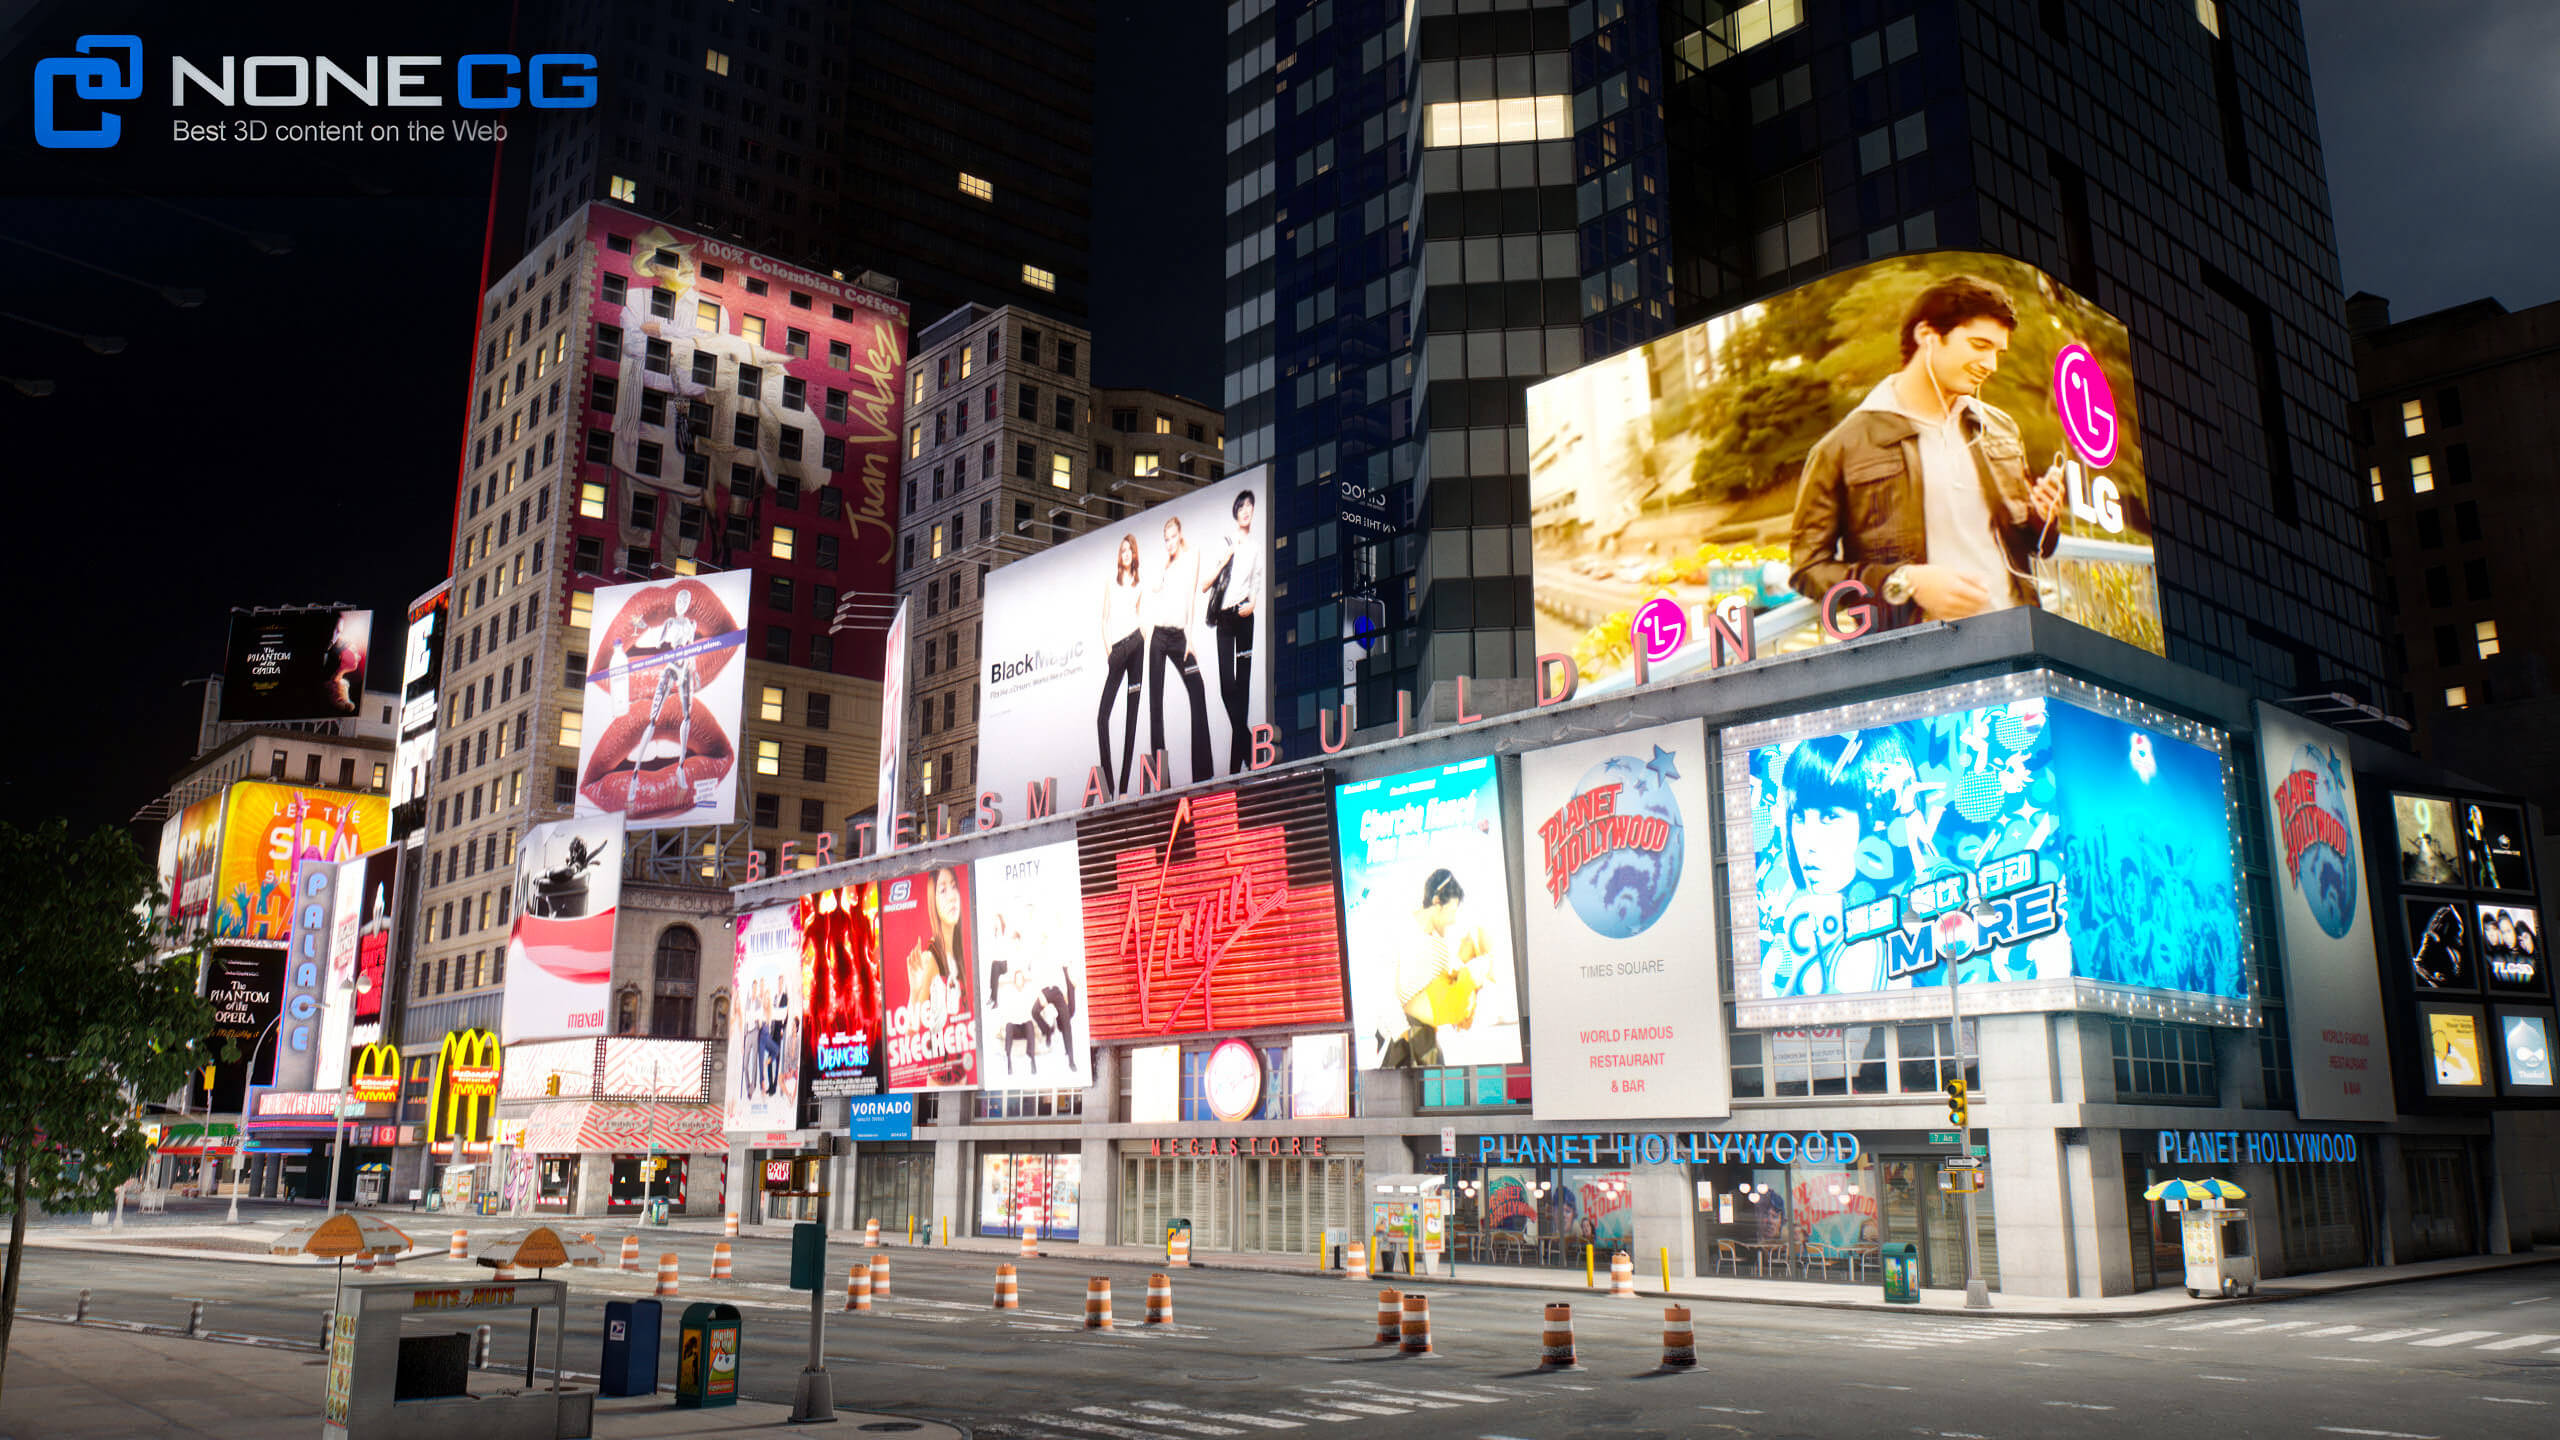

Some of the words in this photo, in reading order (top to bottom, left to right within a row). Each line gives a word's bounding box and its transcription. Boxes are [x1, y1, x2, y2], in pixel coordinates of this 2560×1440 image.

[702, 239, 745, 266] 100%
[750, 255, 841, 297] Colombian
[844, 287, 900, 316] Coffee
[849, 319, 903, 444] Valdez
[845, 453, 896, 565] Juan
[2066, 460, 2125, 534] LG
[1249, 579, 1880, 771] BUILDING
[273, 801, 311, 819] LET
[323, 806, 361, 825] THE
[1537, 781, 1624, 872] PLANET
[2273, 769, 2318, 851] PLANET
[1546, 814, 1671, 908] HOLLYWOOD
[2283, 803, 2348, 890] HOLLYWOOD
[1004, 858, 1041, 881] PARTY
[1119, 796, 1289, 1036] Virgin
[289, 872, 329, 1051] PALACE
[1580, 962, 1614, 979] TIMES
[1617, 958, 1665, 976] SQUARE
[210, 990, 271, 1004] PHANTOM
[215, 1010, 255, 1025] OPERA
[567, 1009, 605, 1029] maxell
[1580, 1028, 1621, 1044] WORLD
[1623, 1025, 1674, 1042] FAMOUS
[1589, 1052, 1665, 1069] RESTAURANT
[1610, 1080, 1619, 1093] &
[1622, 1079, 1646, 1093] BAR
[851, 1100, 912, 1117] VORNADO
[1151, 1136, 1326, 1157] MEGASTORE
[1479, 1135, 1600, 1164] PLANET
[1617, 1132, 1861, 1165] HOLLYWOOD
[2158, 1130, 2240, 1164] PLANET
[2246, 1131, 2357, 1164] HOLLYWOOD
